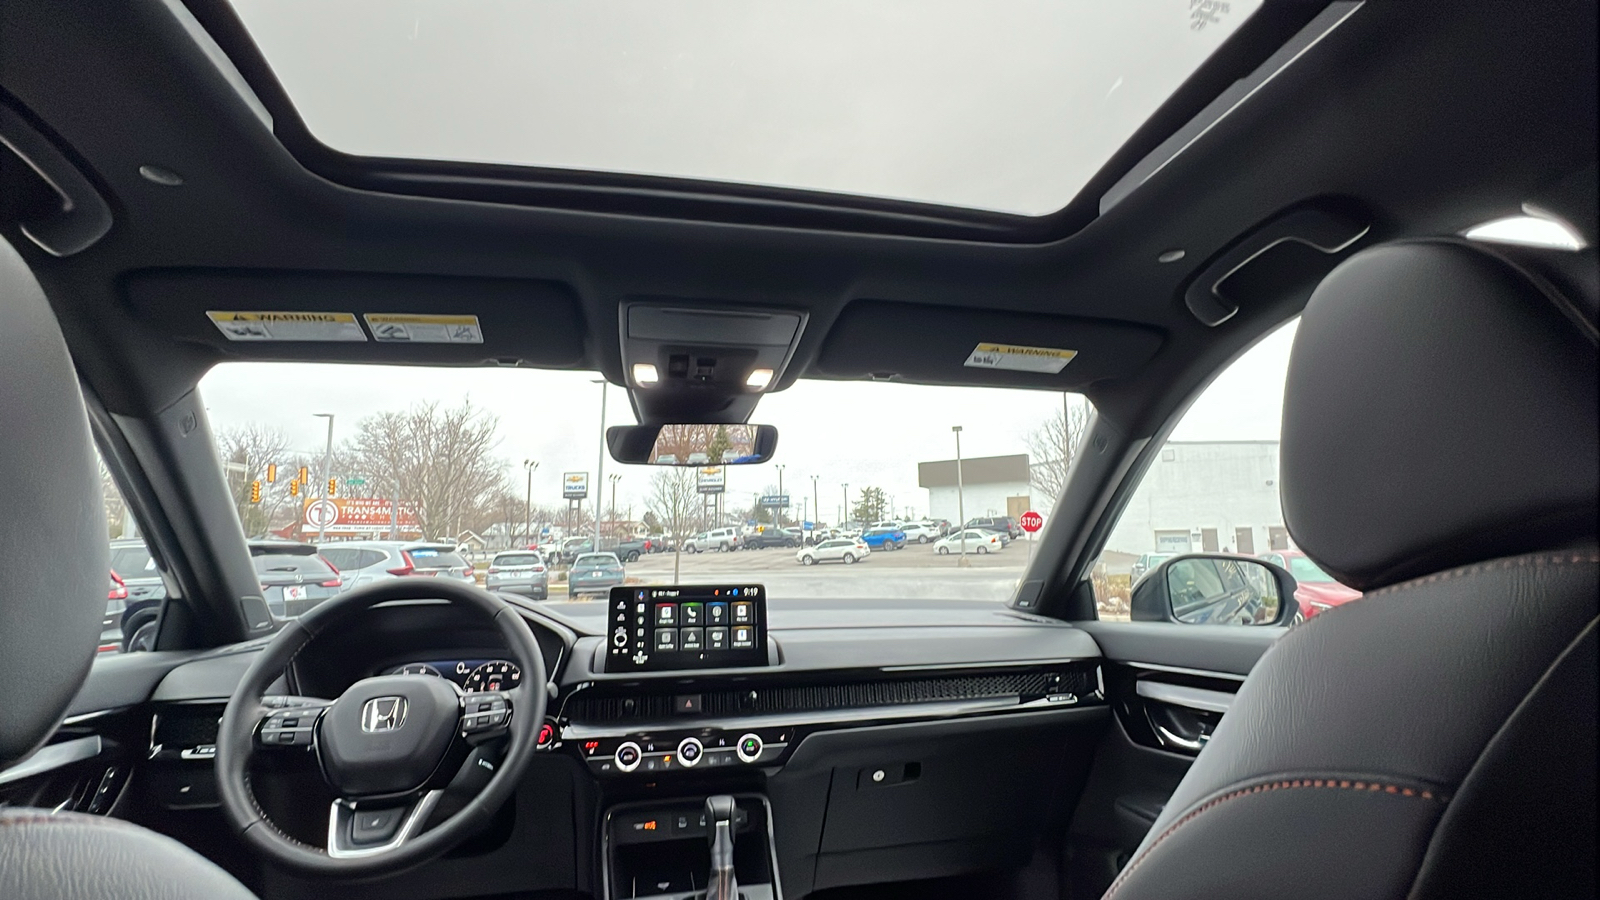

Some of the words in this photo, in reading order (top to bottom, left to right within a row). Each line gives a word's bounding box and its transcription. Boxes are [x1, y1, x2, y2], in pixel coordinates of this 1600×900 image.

[257, 313, 336, 322] WARNING
[1007, 346, 1061, 357] WARNING
[341, 506, 423, 516] TRANS4MTION
[1021, 517, 1042, 528] STOP
[743, 587, 758, 597] 9:19
